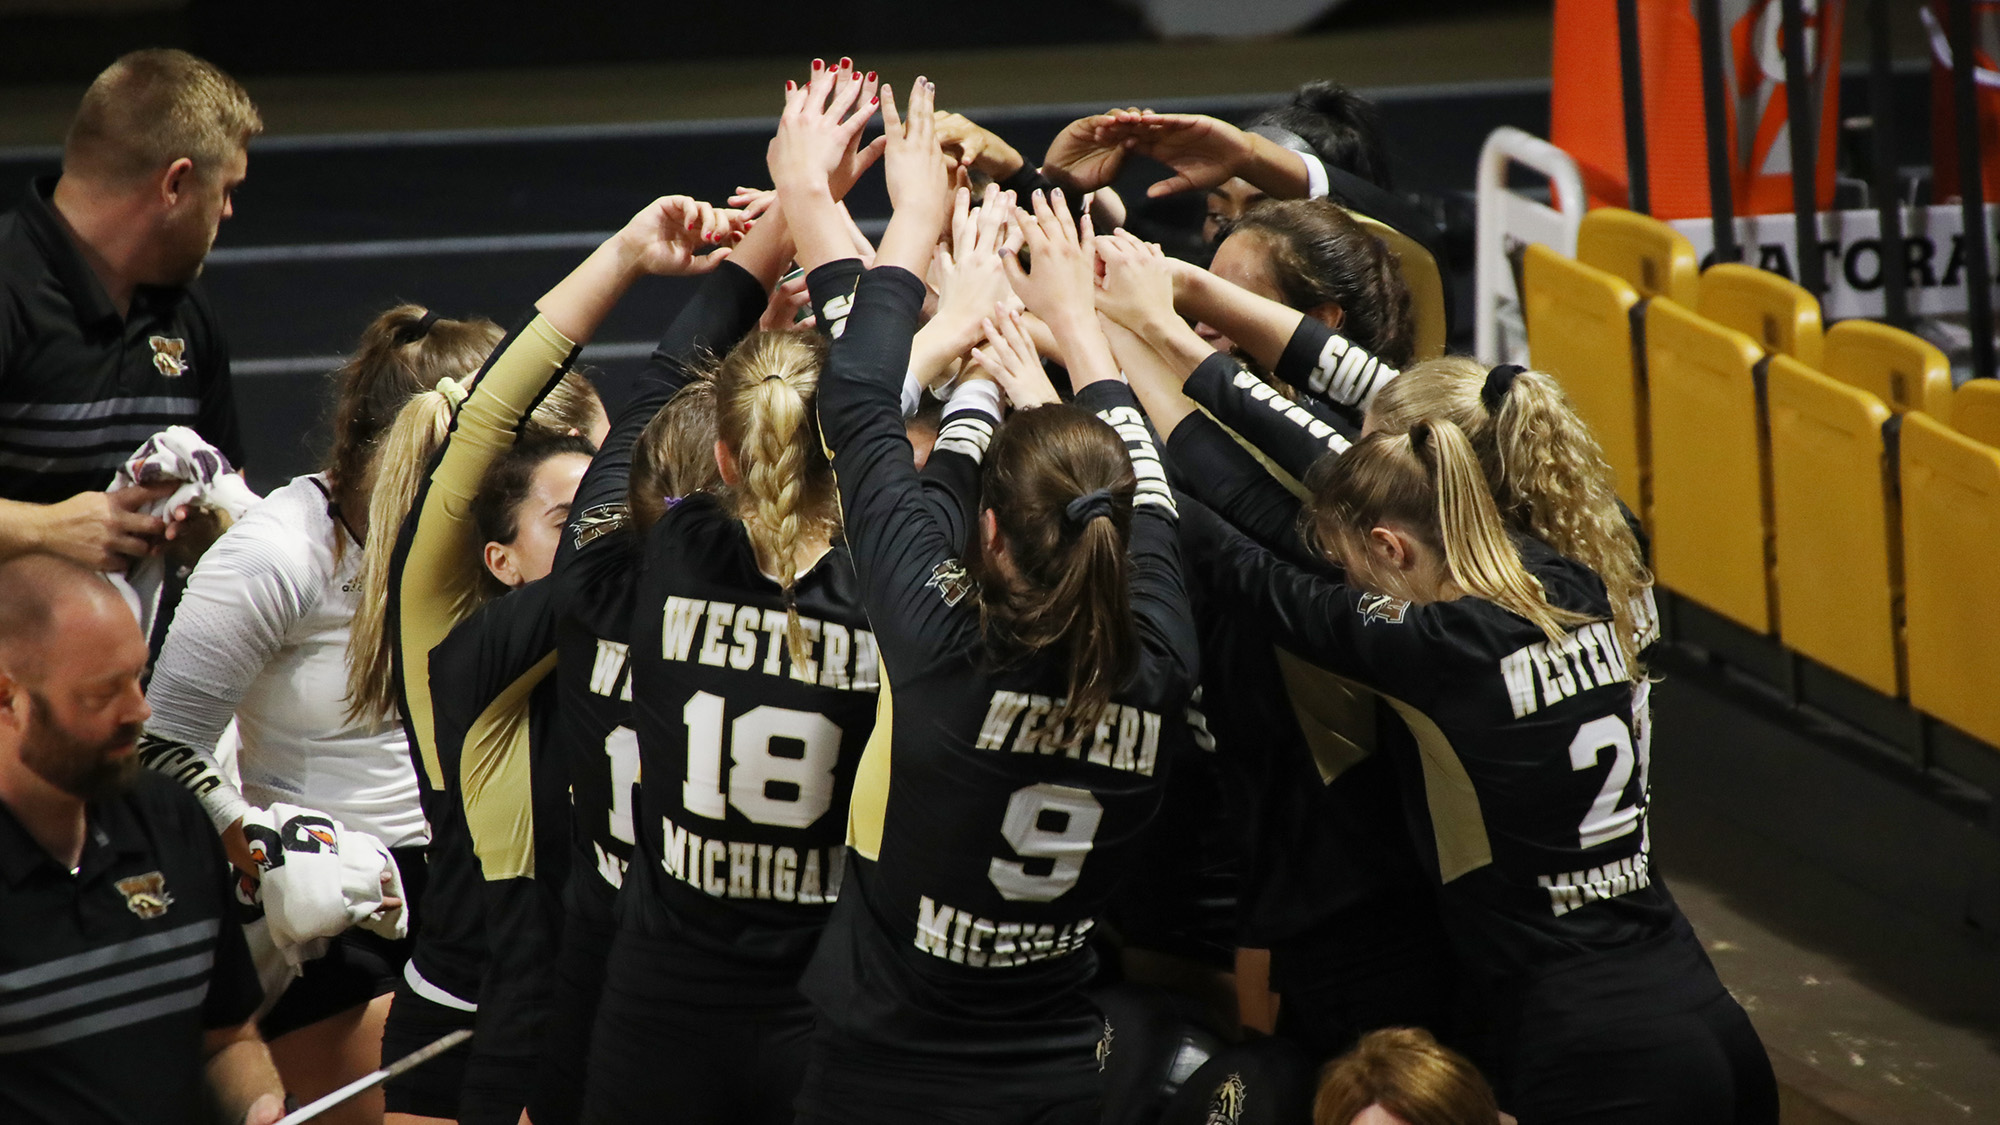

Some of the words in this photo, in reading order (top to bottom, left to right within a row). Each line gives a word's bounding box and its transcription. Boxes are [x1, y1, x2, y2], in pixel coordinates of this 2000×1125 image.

[661, 595, 880, 693] WESTERN
[683, 689, 844, 829] 18
[987, 782, 1104, 902] 9
